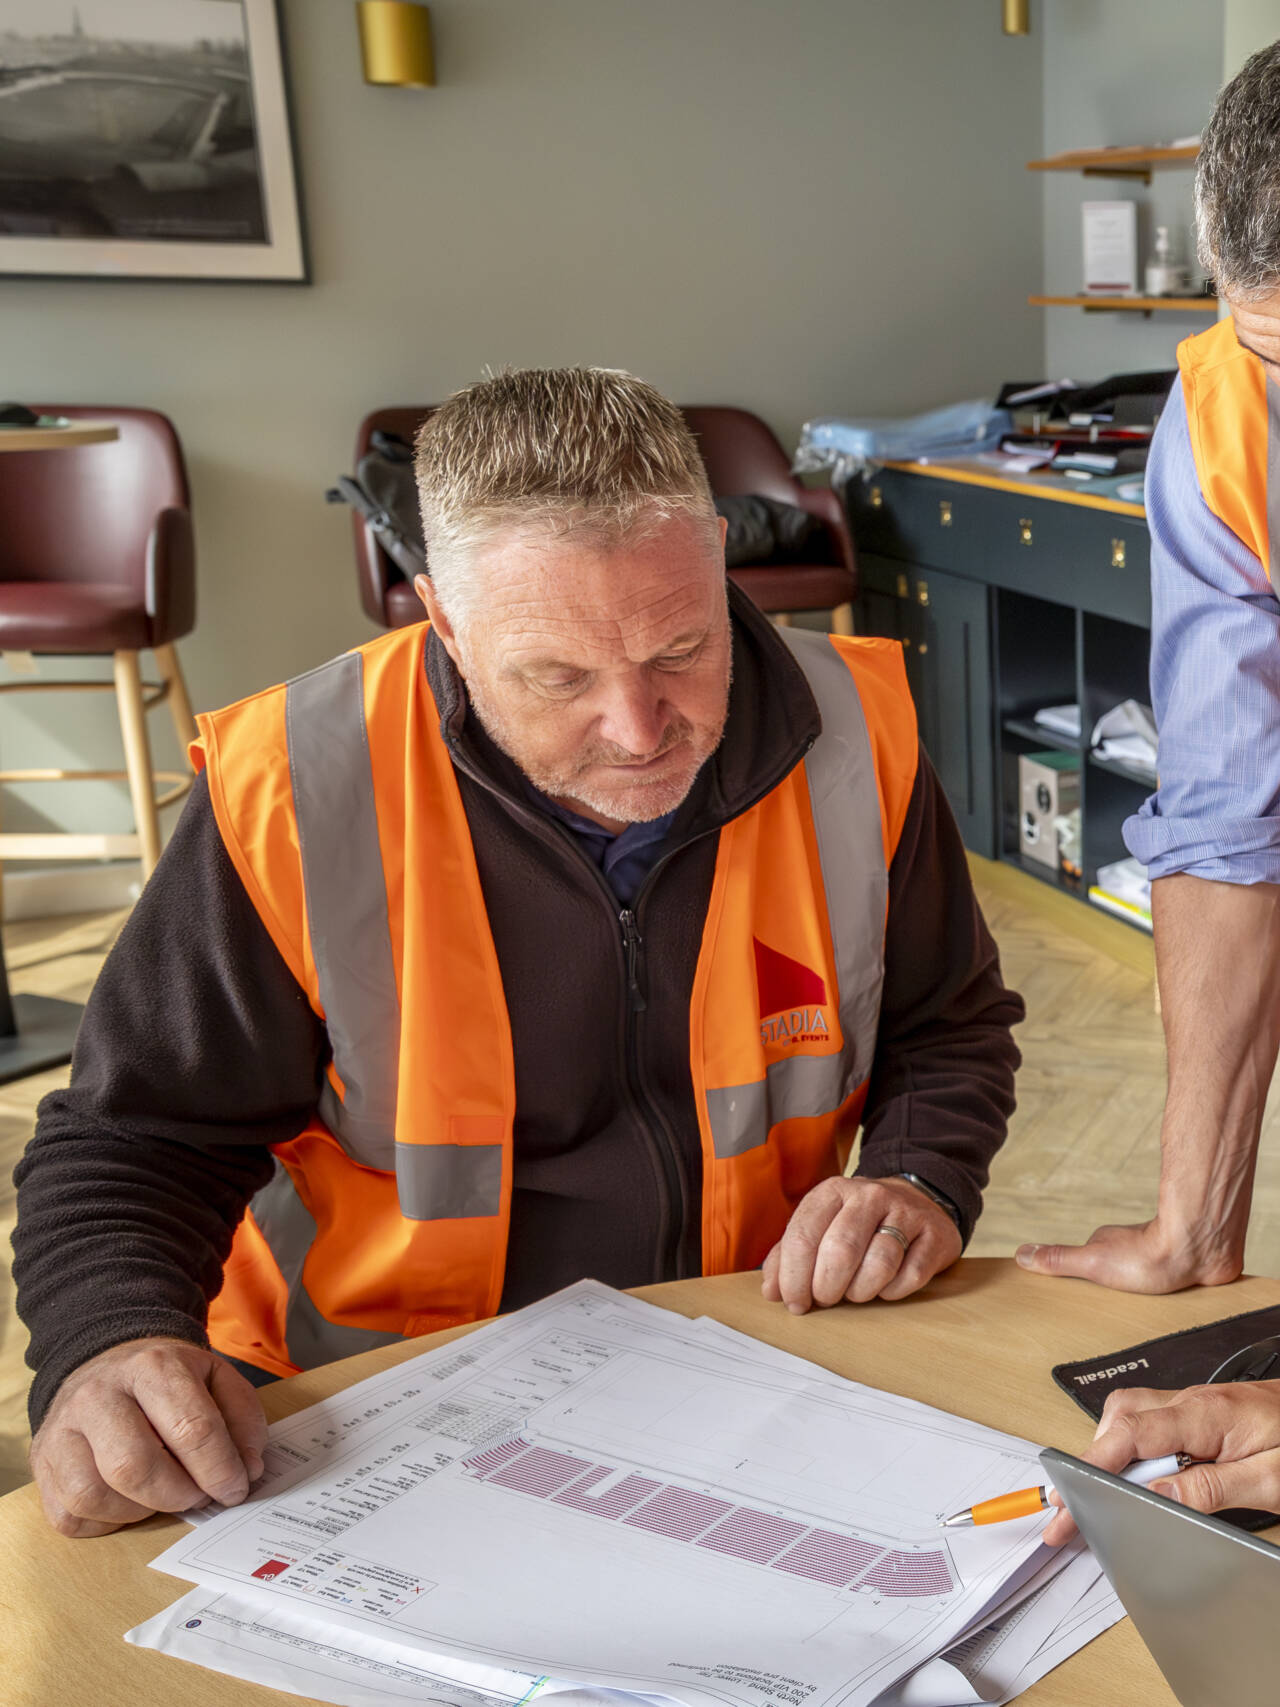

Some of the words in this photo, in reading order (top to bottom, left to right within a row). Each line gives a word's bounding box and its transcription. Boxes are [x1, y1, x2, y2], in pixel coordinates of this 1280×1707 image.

[760, 1008, 828, 1045] STADIA
[735, 1672, 774, 1686] locations
[780, 1676, 805, 1687] client
[747, 1682, 776, 1695] Stand
[773, 1683, 790, 1692] VIP
[791, 1688, 810, 1699] 200
[805, 1684, 817, 1692] by
[776, 1692, 802, 1706] North
